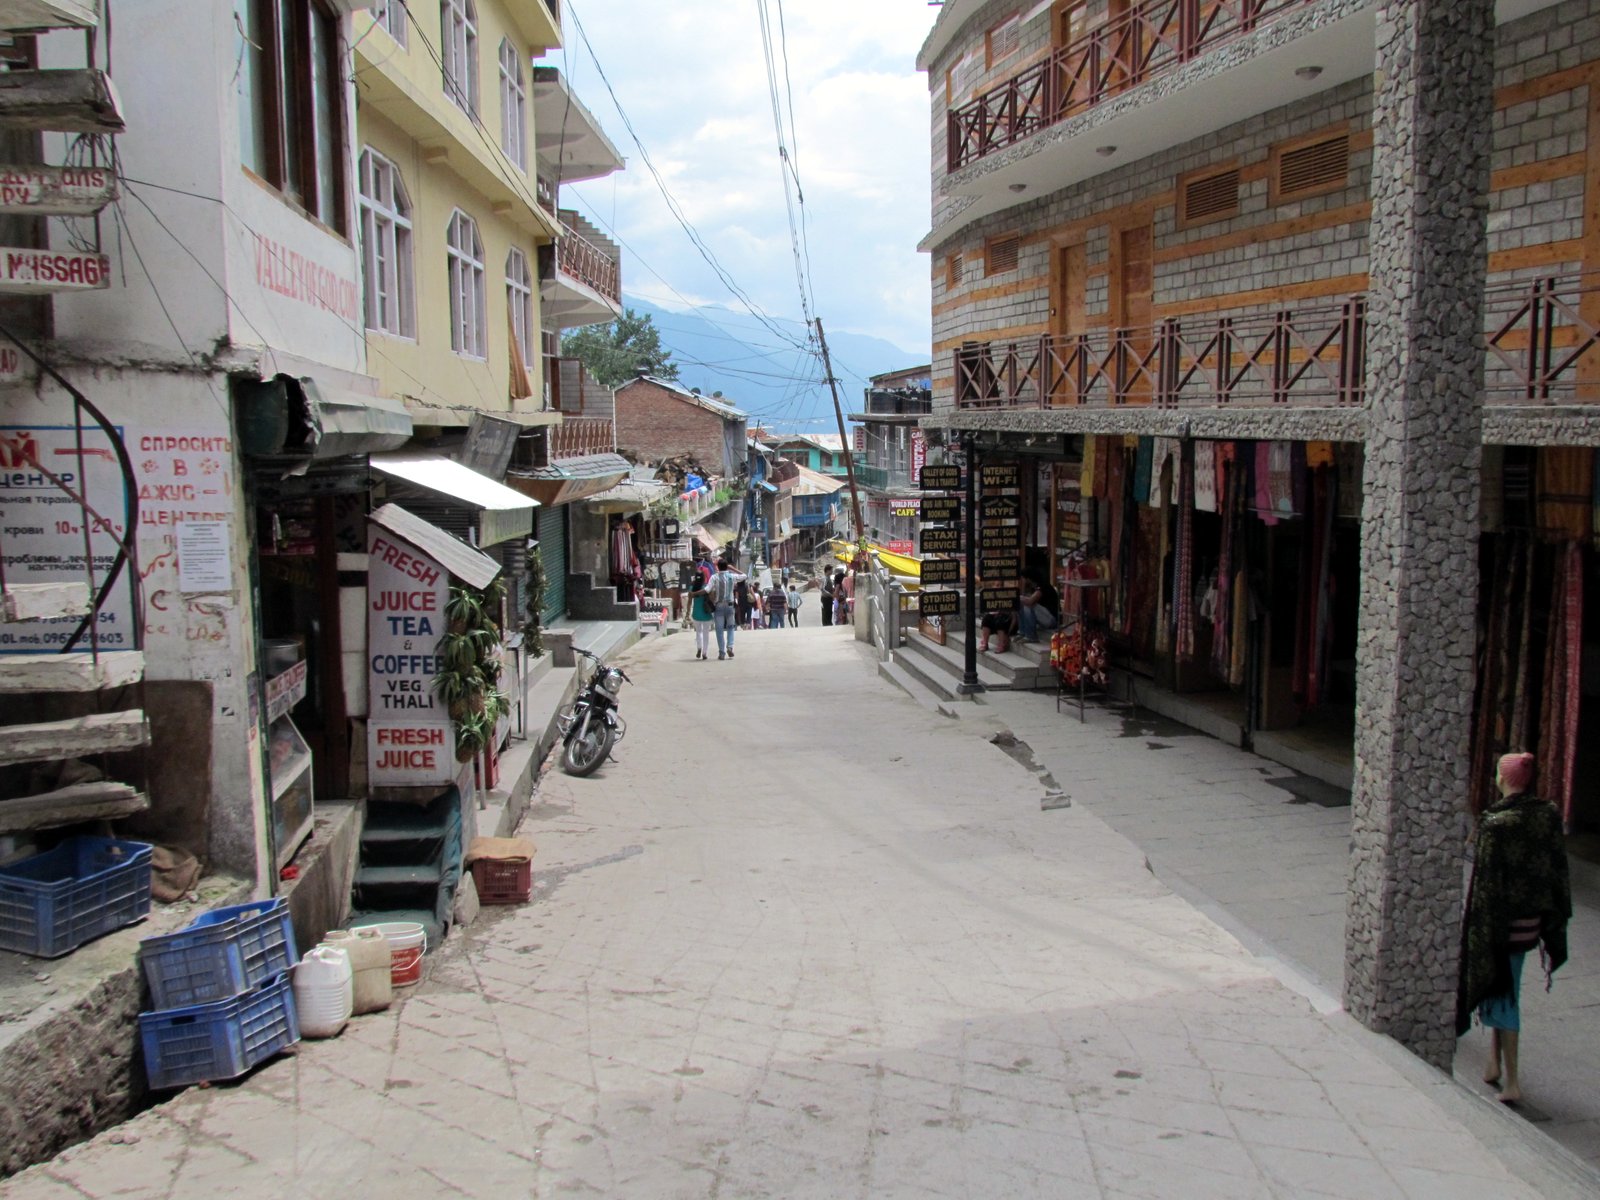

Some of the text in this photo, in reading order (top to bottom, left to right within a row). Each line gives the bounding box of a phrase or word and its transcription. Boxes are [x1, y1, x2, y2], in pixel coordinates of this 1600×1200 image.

[983, 466, 1017, 475] INTERNET
[983, 476, 1017, 485] WI-FI
[896, 508, 915, 516] CAFE
[985, 507, 1015, 516] SKYPE
[933, 531, 957, 539] TAXI
[923, 541, 957, 550] SERVICE
[370, 537, 440, 587] FRESH
[373, 591, 437, 611] JUICE
[923, 603, 956, 613] CALL BACK
[386, 616, 433, 636] TEA
[386, 680, 425, 692] VEG.
[381, 694, 434, 709] THALI
[376, 728, 445, 746] FRESH
[375, 750, 437, 770] JUICE
